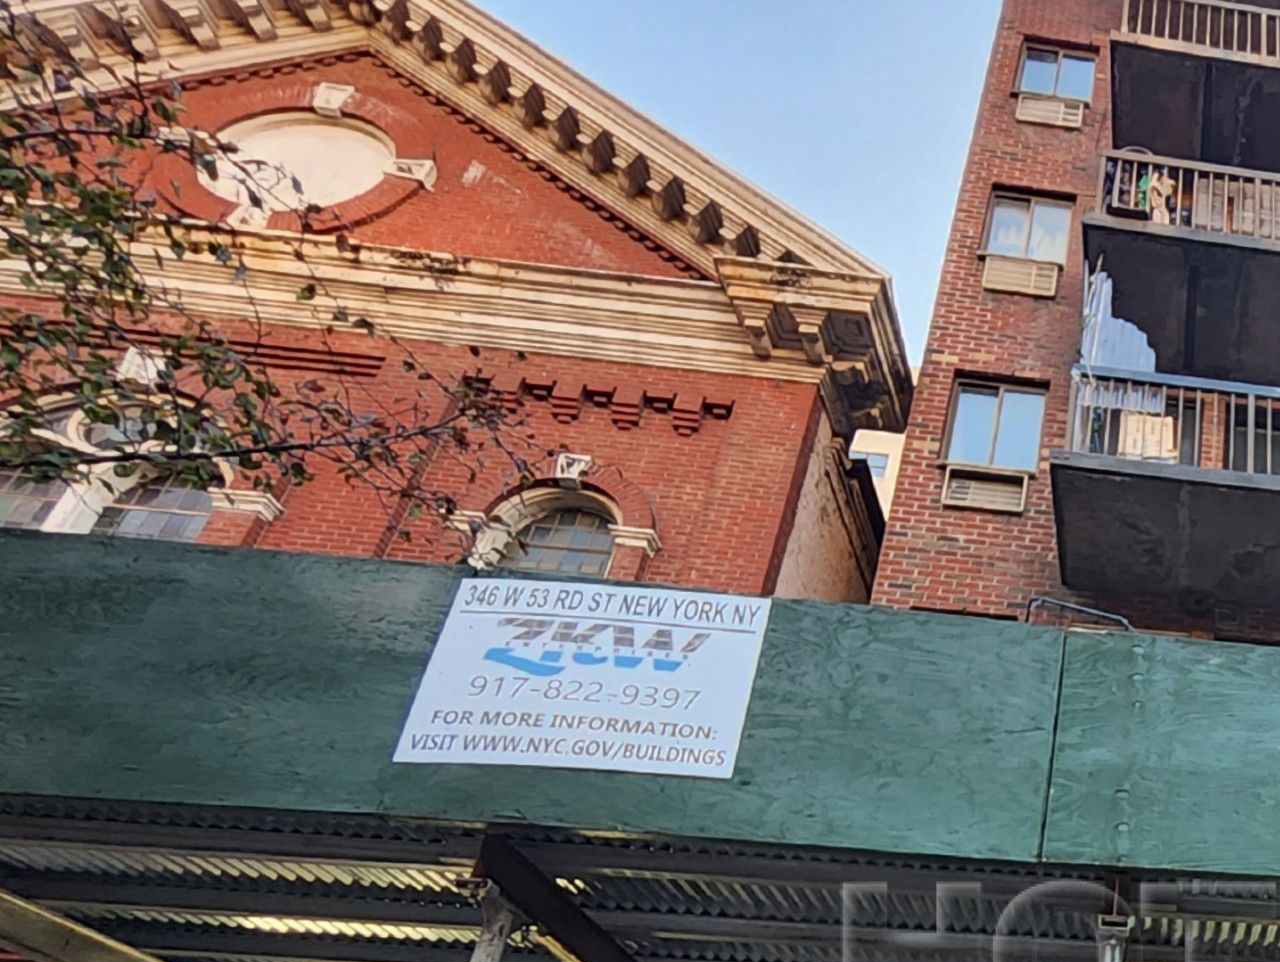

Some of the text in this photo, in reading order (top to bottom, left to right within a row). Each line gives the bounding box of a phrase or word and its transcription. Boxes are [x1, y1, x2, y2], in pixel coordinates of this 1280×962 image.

[465, 585, 761, 626] 346 W 53 RD ST NEW YORK NY
[468, 675, 701, 710] 917-822-9397
[430, 710, 718, 740] FOR MORE INFORMATION:
[411, 734, 727, 765] VISIT WWW.NYC.GOV/BUILDINGS
